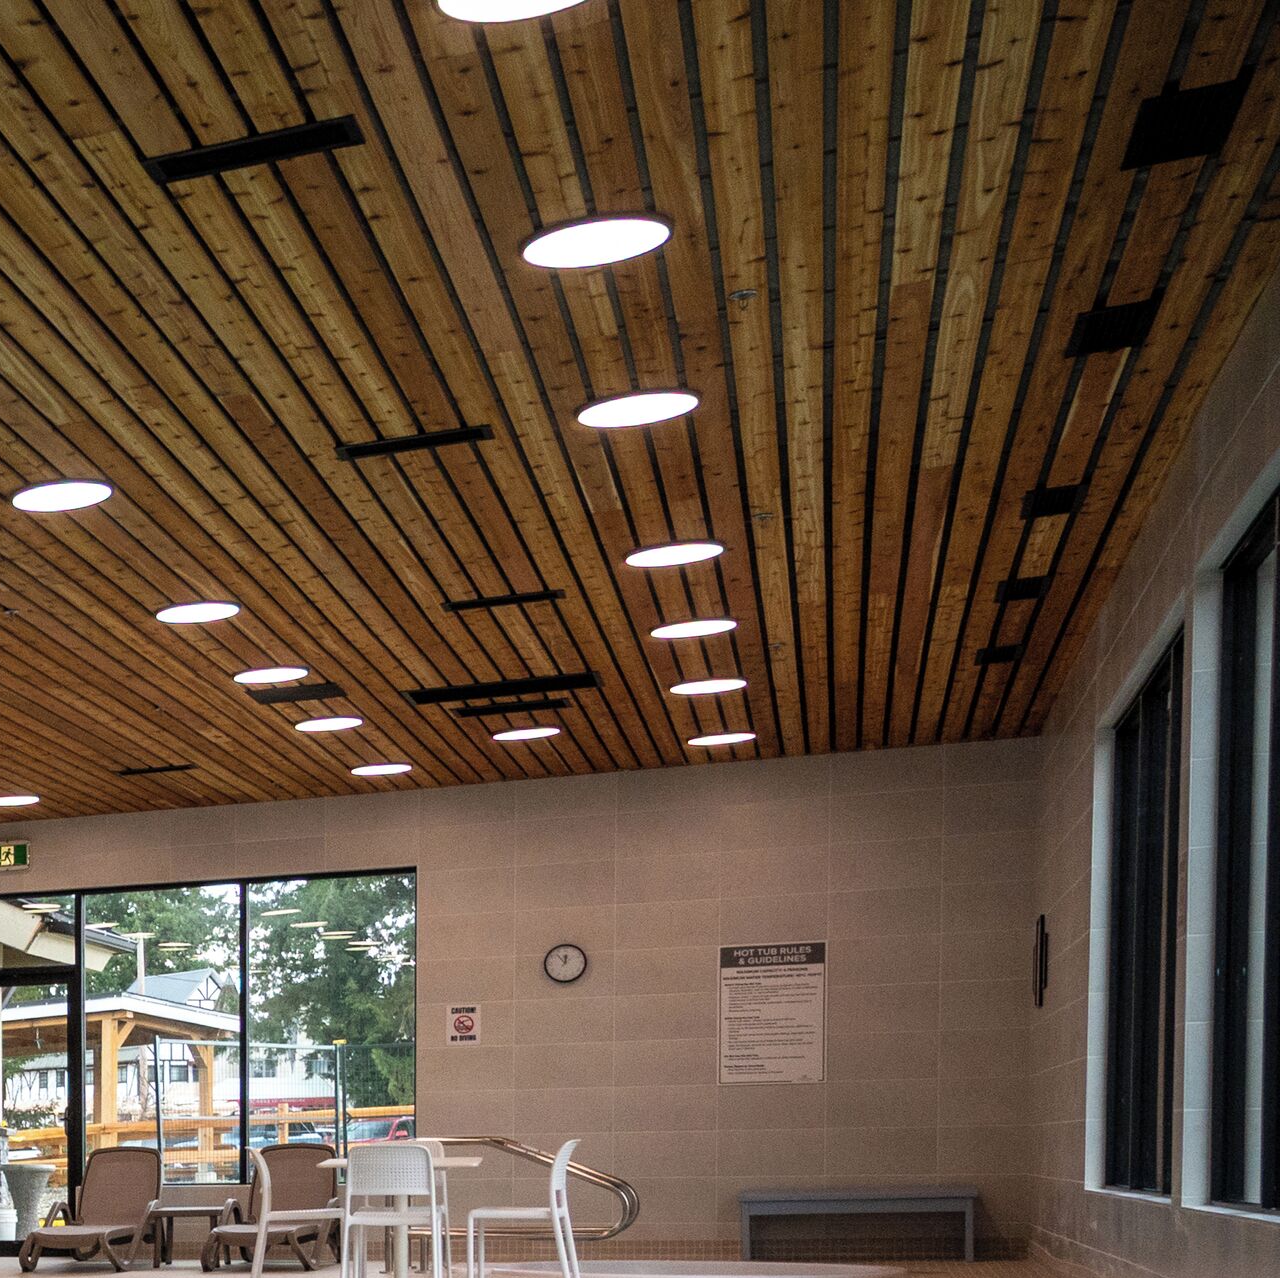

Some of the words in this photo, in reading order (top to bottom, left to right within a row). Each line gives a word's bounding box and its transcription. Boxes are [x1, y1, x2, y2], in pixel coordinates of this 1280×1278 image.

[733, 948, 755, 957] HOT
[757, 947, 777, 956] TUB
[780, 945, 812, 955] RULES
[738, 957, 745, 965] &
[747, 954, 807, 965] GUIDELINES
